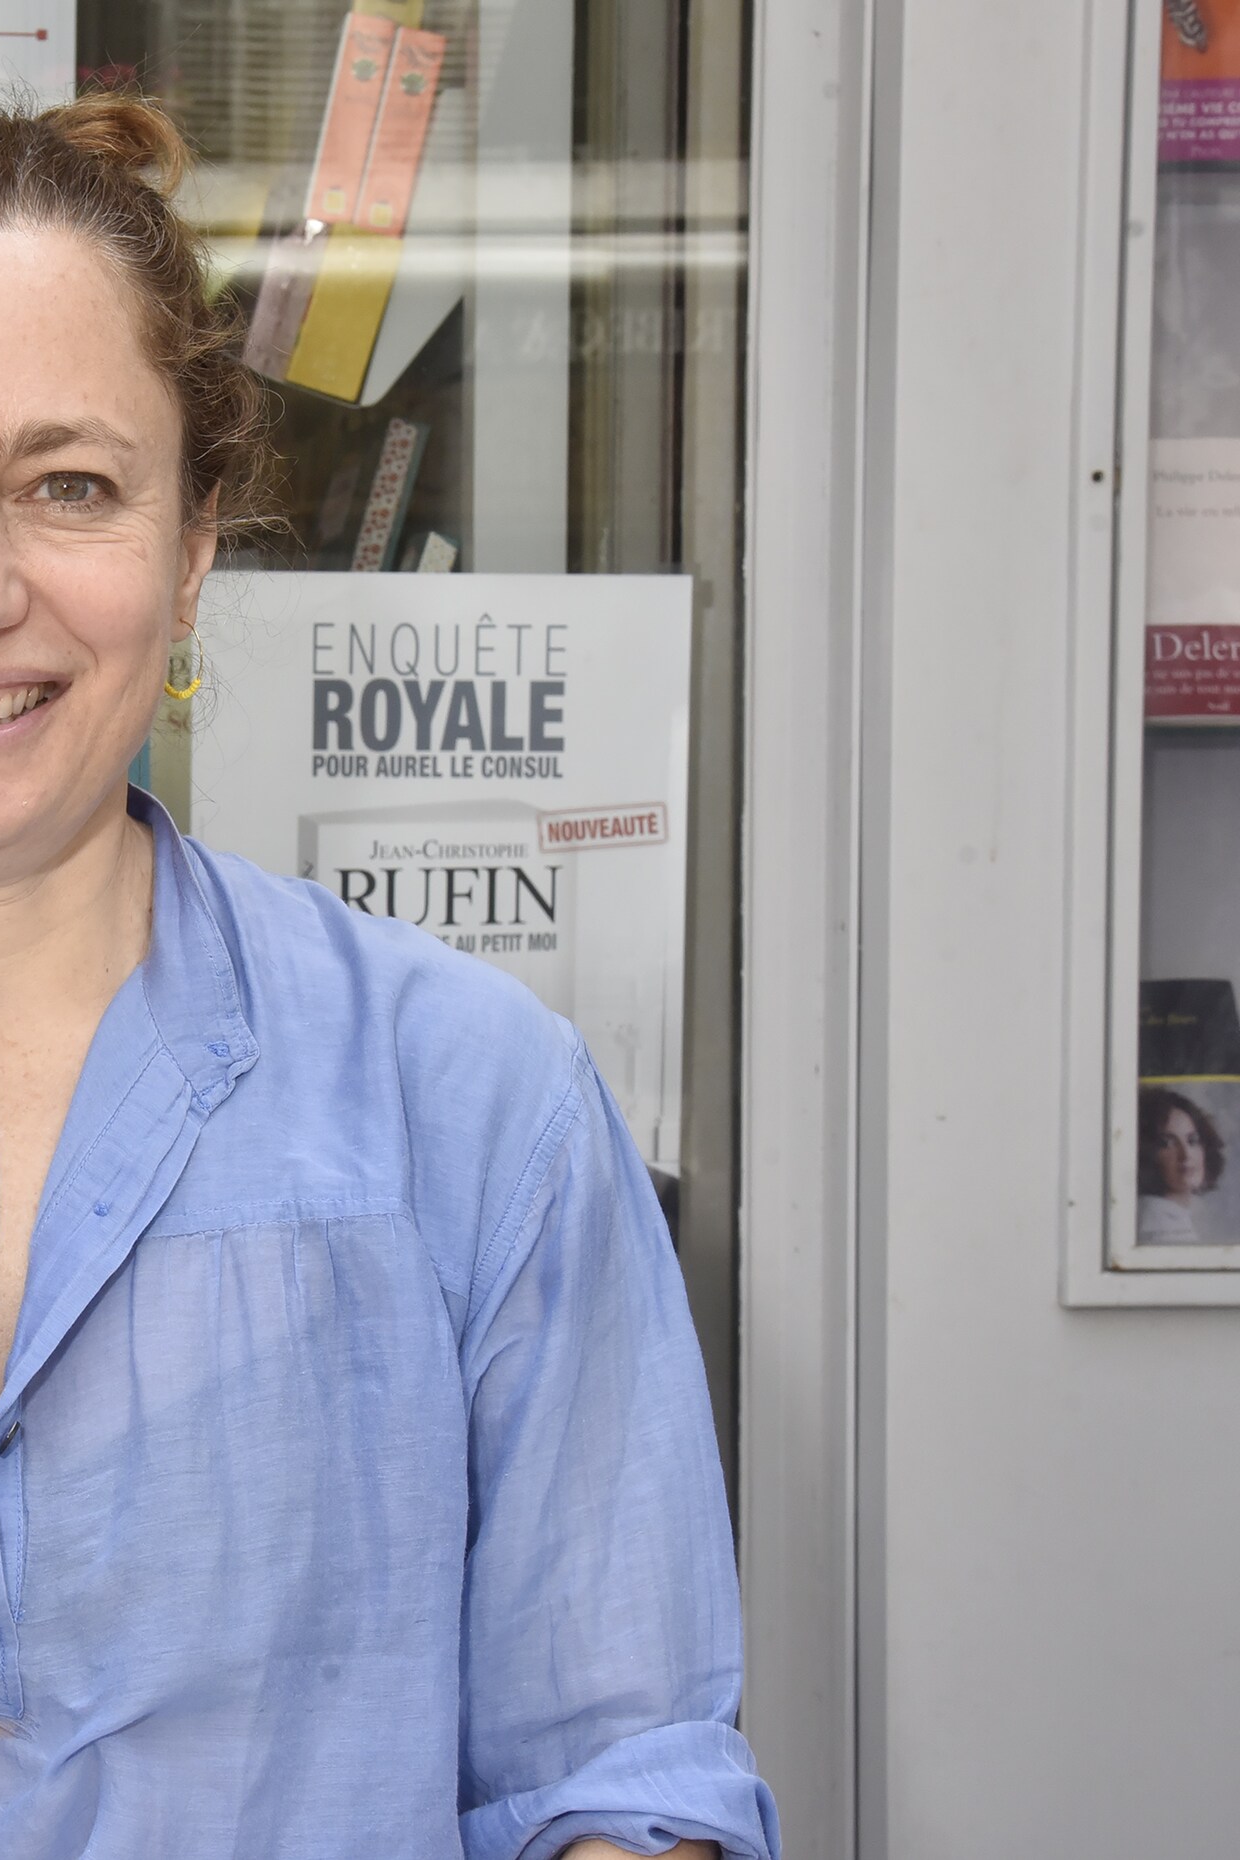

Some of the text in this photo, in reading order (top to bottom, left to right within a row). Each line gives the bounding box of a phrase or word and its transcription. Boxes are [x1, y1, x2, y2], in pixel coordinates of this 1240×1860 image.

[313, 613, 567, 677] ENQUÊTE
[312, 677, 565, 752] ROYALE
[312, 755, 563, 779] POUR AUREL LE CONSUL
[548, 813, 659, 842] NOUVEAUTÉ
[369, 839, 528, 860] JEAN-CHRISTOPHE
[334, 865, 563, 926] RUFIN
[456, 934, 476, 953] AU
[481, 933, 523, 952] PETIT
[528, 932, 557, 951] MOI
